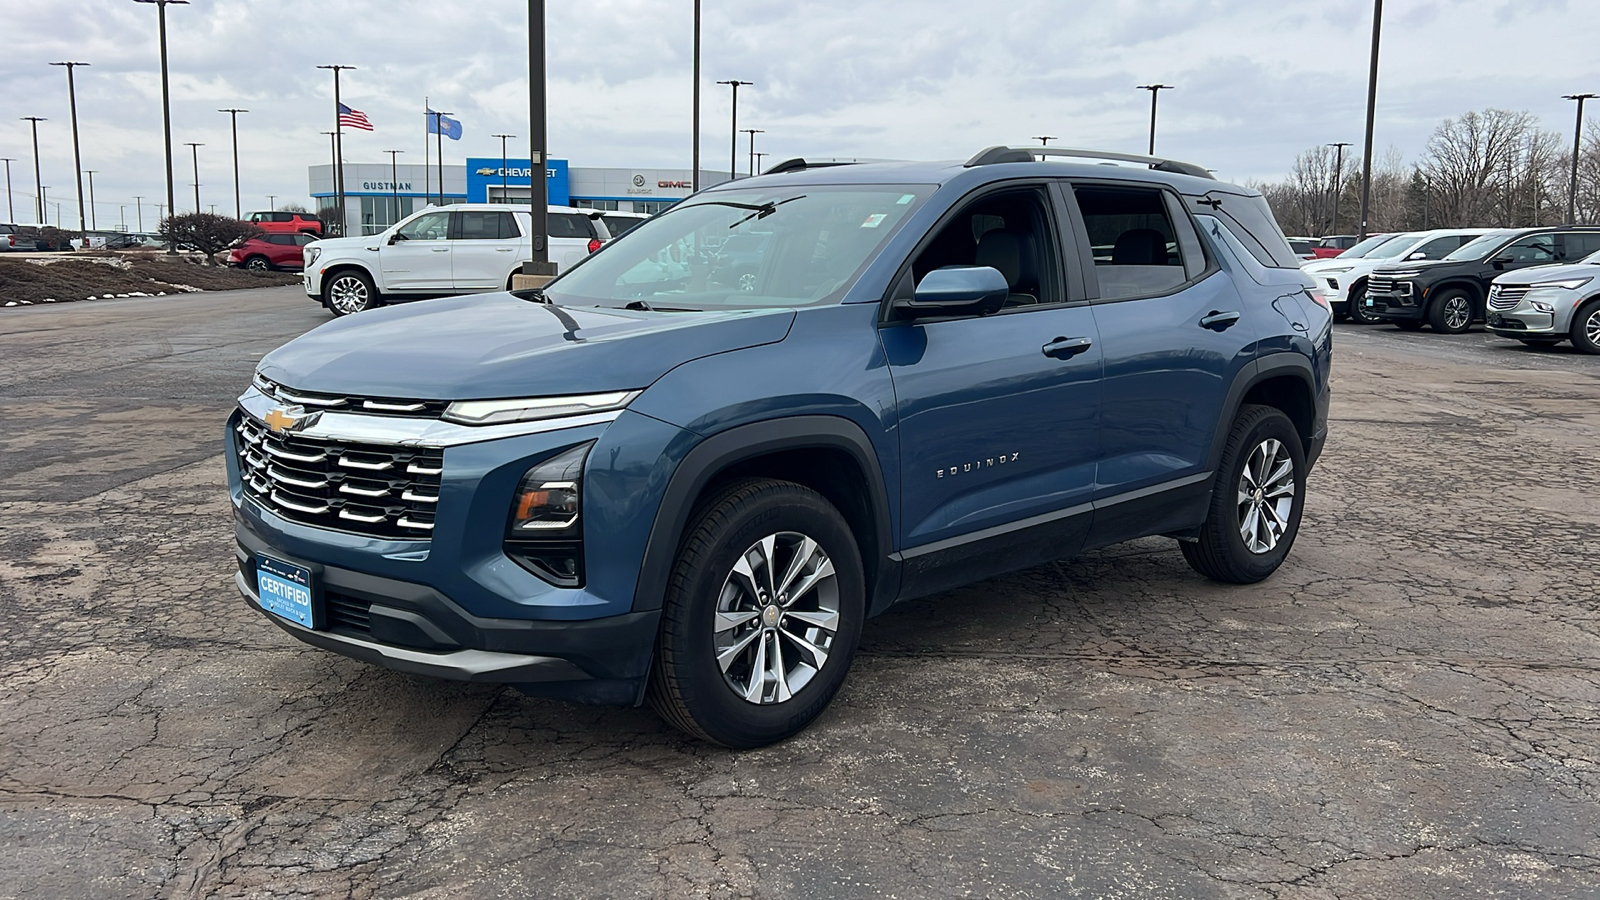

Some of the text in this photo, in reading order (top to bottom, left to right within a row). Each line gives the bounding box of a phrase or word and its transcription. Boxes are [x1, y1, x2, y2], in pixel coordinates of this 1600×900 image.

[498, 168, 557, 178] CHEVRET
[363, 182, 411, 190] GUSTMAN
[937, 452, 1019, 478] EQUINOX
[260, 576, 309, 607] CERTIFIED
